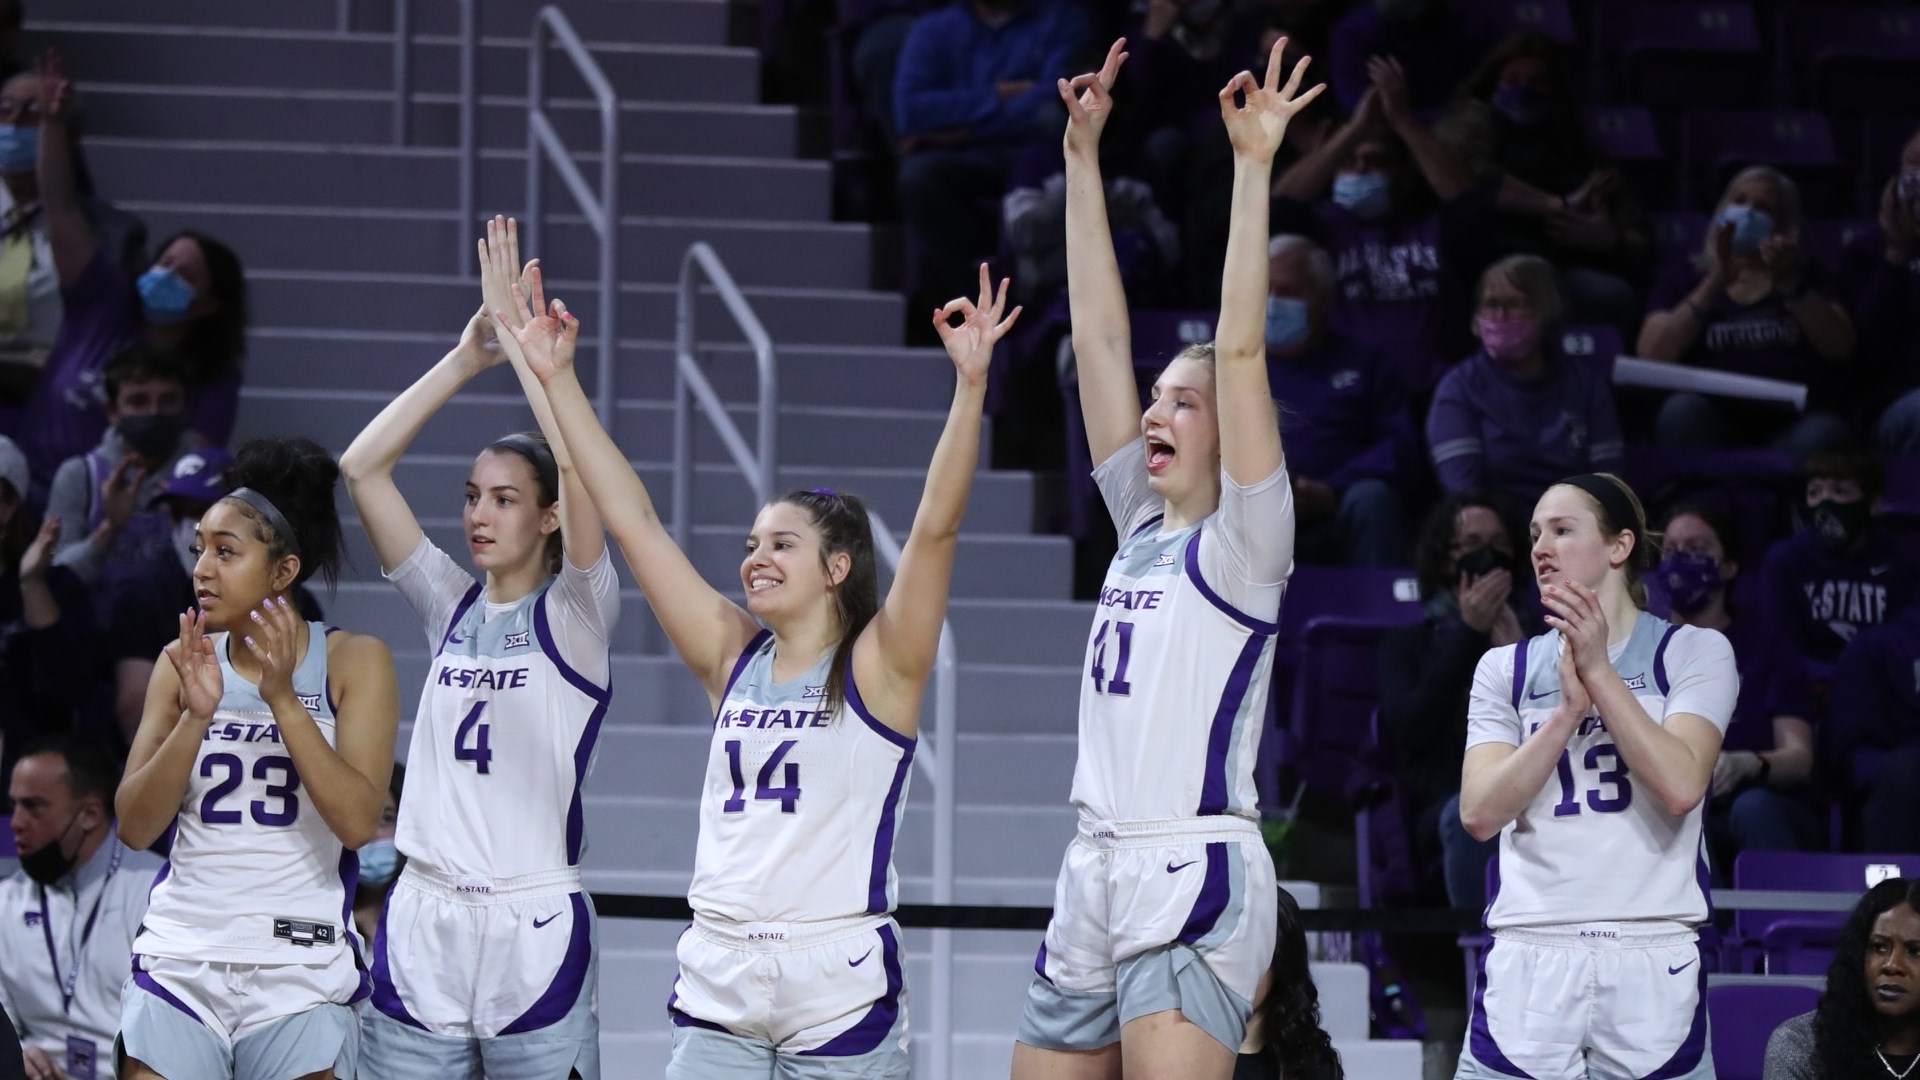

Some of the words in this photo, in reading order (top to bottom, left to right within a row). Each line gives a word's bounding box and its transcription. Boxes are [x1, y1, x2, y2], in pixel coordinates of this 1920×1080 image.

[504, 630, 530, 650] XII
[1091, 619, 1134, 696] 41
[438, 666, 529, 690] K-STATE
[720, 709, 833, 729] K-STATE
[203, 722, 281, 744] -STA
[454, 700, 492, 775] 4
[723, 740, 801, 813] 14
[1554, 743, 1632, 817] 13
[200, 752, 300, 827] 23
[456, 885, 492, 894] K-STATE
[316, 928, 328, 938] 42
[748, 932, 786, 940] K-STATE
[1580, 930, 1619, 939] K-STATE
